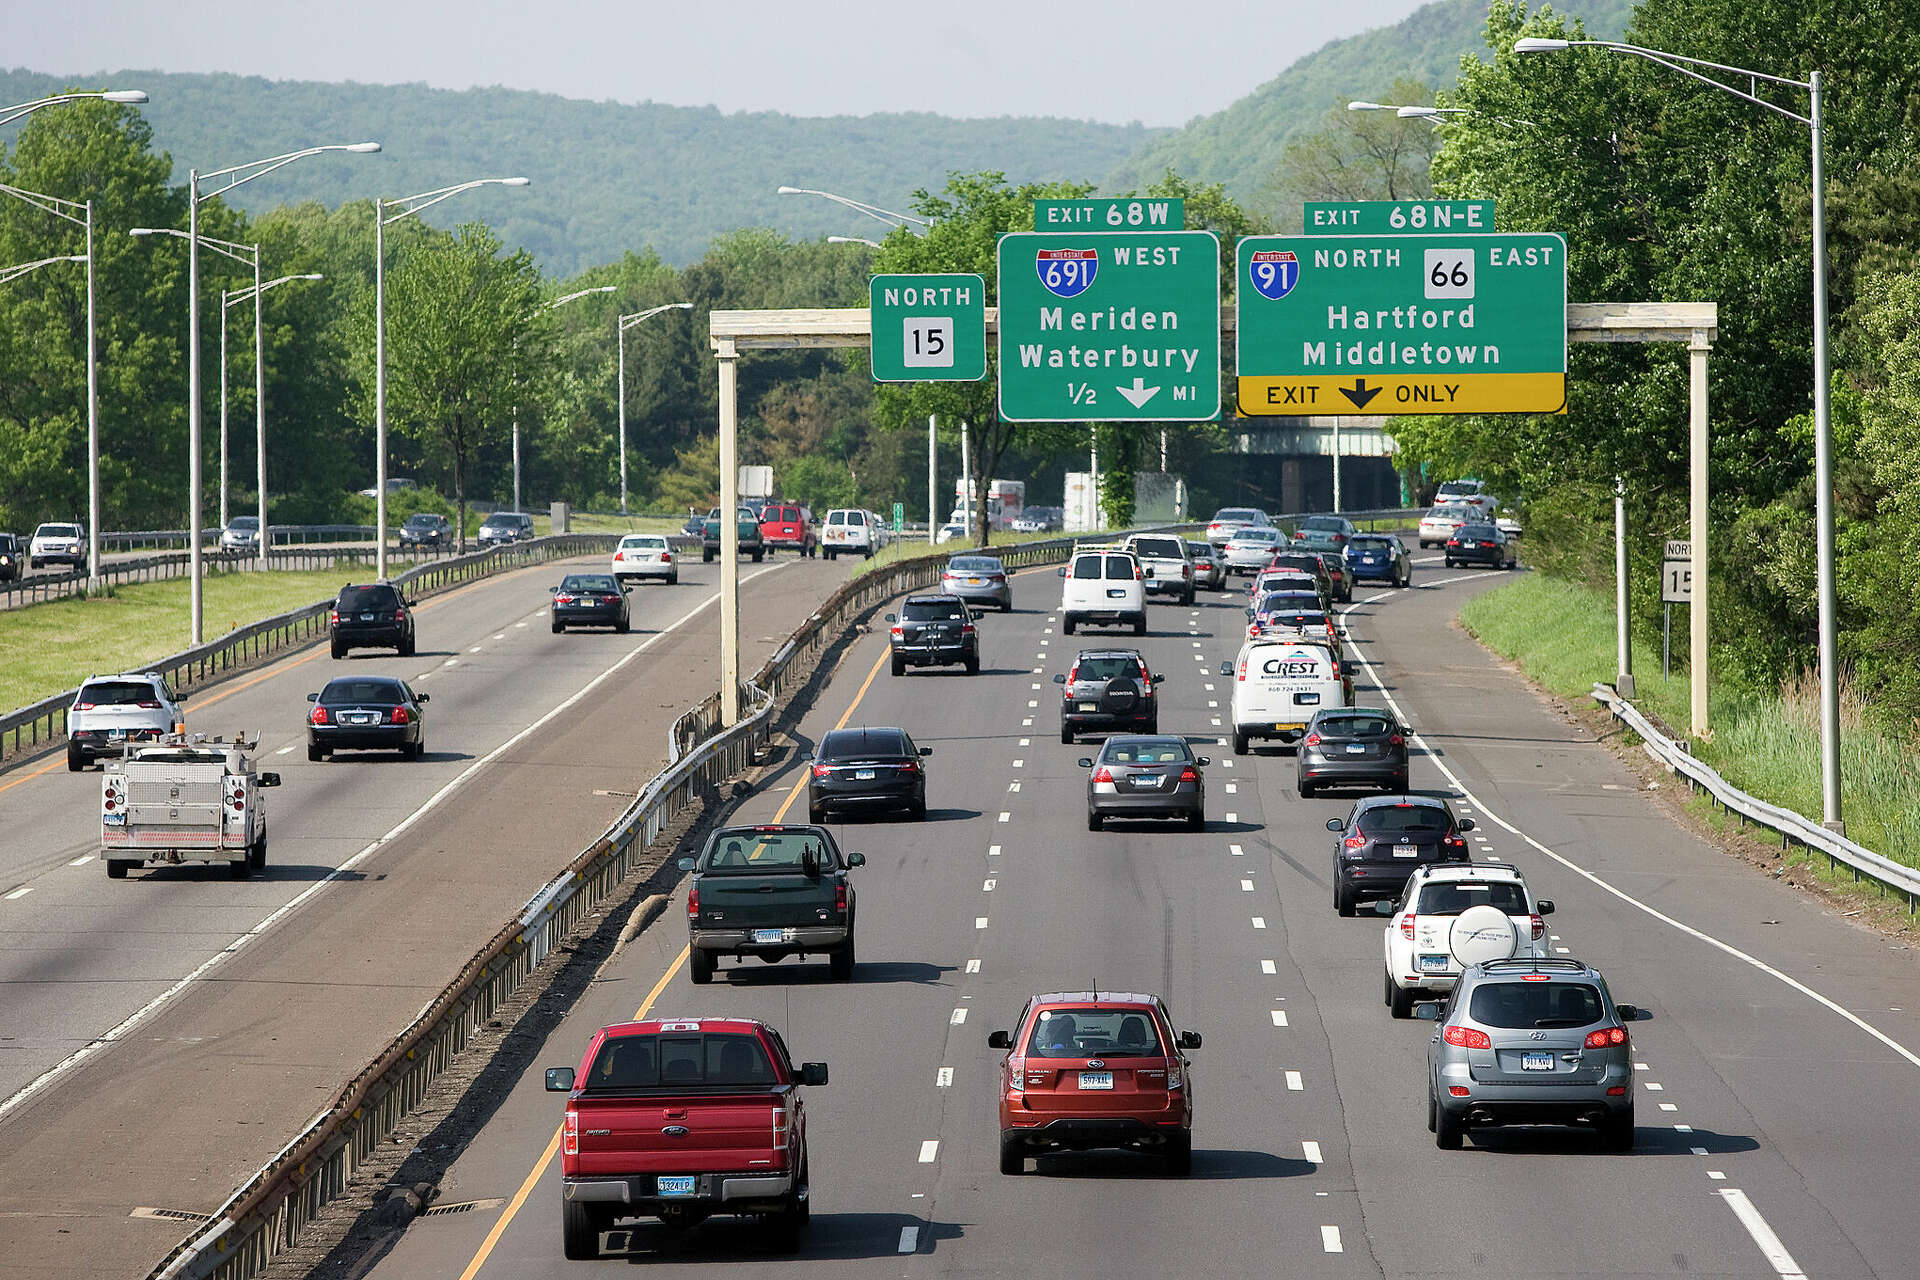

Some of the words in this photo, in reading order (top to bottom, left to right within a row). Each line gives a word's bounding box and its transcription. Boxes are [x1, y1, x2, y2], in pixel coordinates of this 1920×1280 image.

[1047, 207, 1094, 223] EXIT
[1106, 202, 1169, 226] 68W
[1314, 209, 1361, 226] EXIT
[1389, 204, 1483, 229] 68N-E
[1114, 247, 1181, 266] WEST
[1314, 249, 1400, 268] NORTH
[1490, 247, 1553, 266] EAST
[1046, 260, 1088, 288] 691
[1257, 263, 1288, 290] 91
[1430, 260, 1469, 288] 66
[884, 287, 970, 307] NORTH
[1040, 306, 1178, 331] Meriden
[1328, 304, 1474, 330] Hartford
[912, 328, 944, 355] 15
[1303, 340, 1500, 366] Middletown
[1019, 343, 1199, 373] Waterbury
[1173, 385, 1196, 401] MI
[1267, 386, 1320, 404] EXIT
[1396, 384, 1460, 403] ONLY
[1263, 659, 1318, 675] CREST
